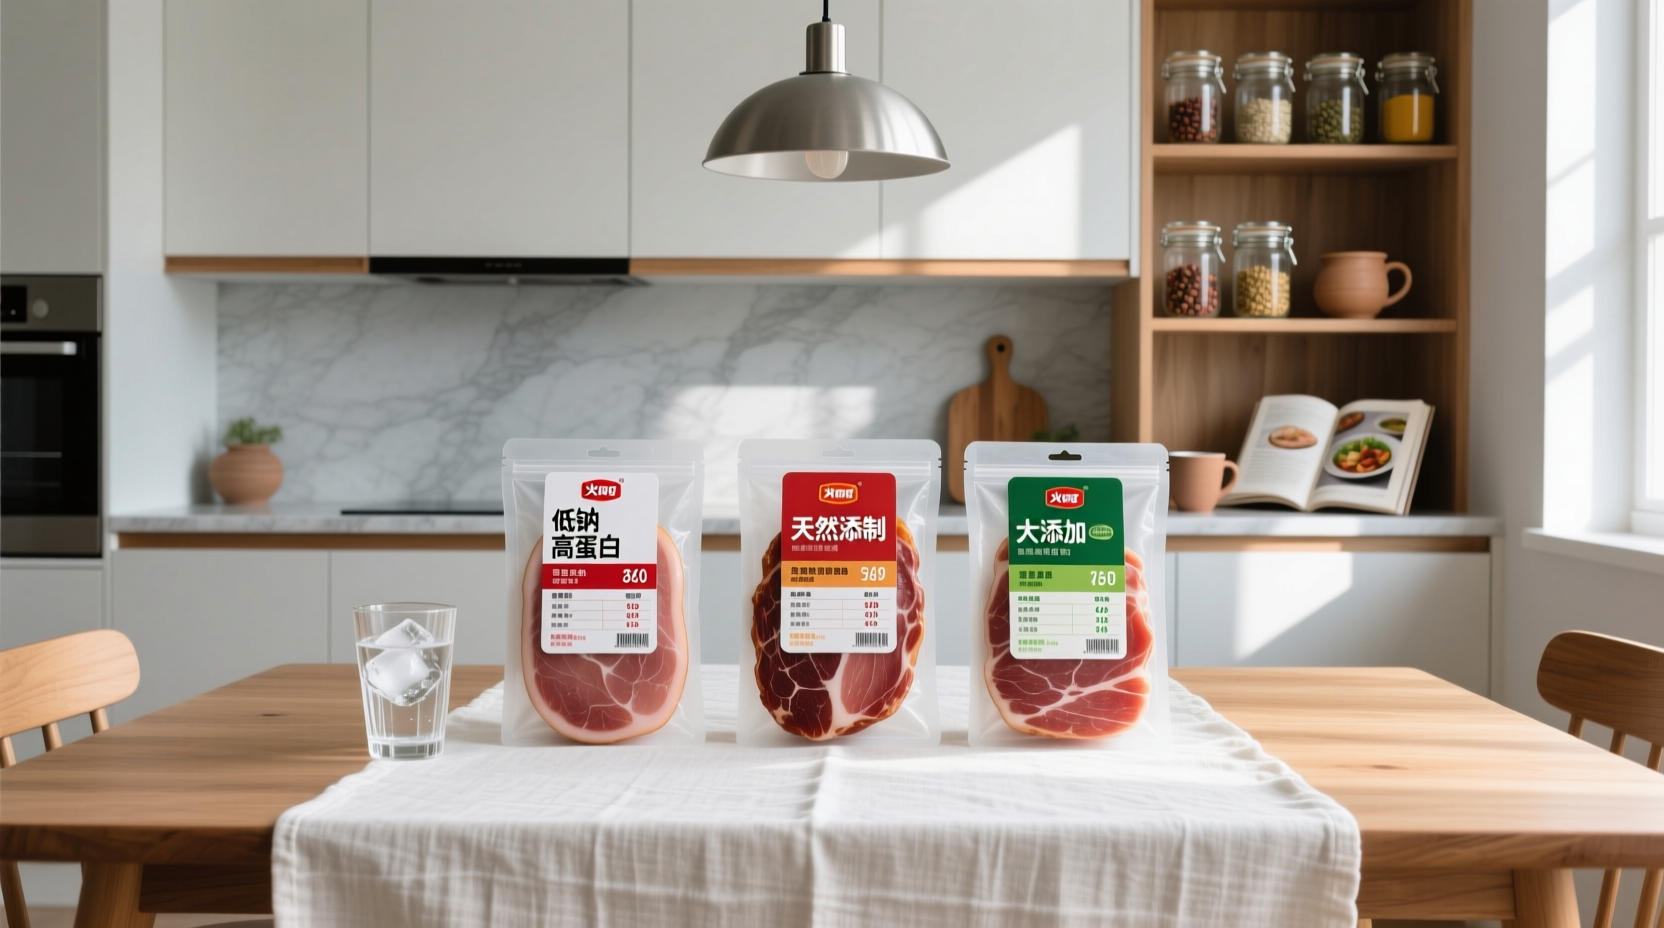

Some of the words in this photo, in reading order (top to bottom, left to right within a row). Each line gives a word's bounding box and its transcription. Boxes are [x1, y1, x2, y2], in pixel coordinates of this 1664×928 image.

[552, 507, 599, 532] 低钠
[1016, 518, 1086, 544] 大添加
[552, 534, 620, 559] 高蛋白
